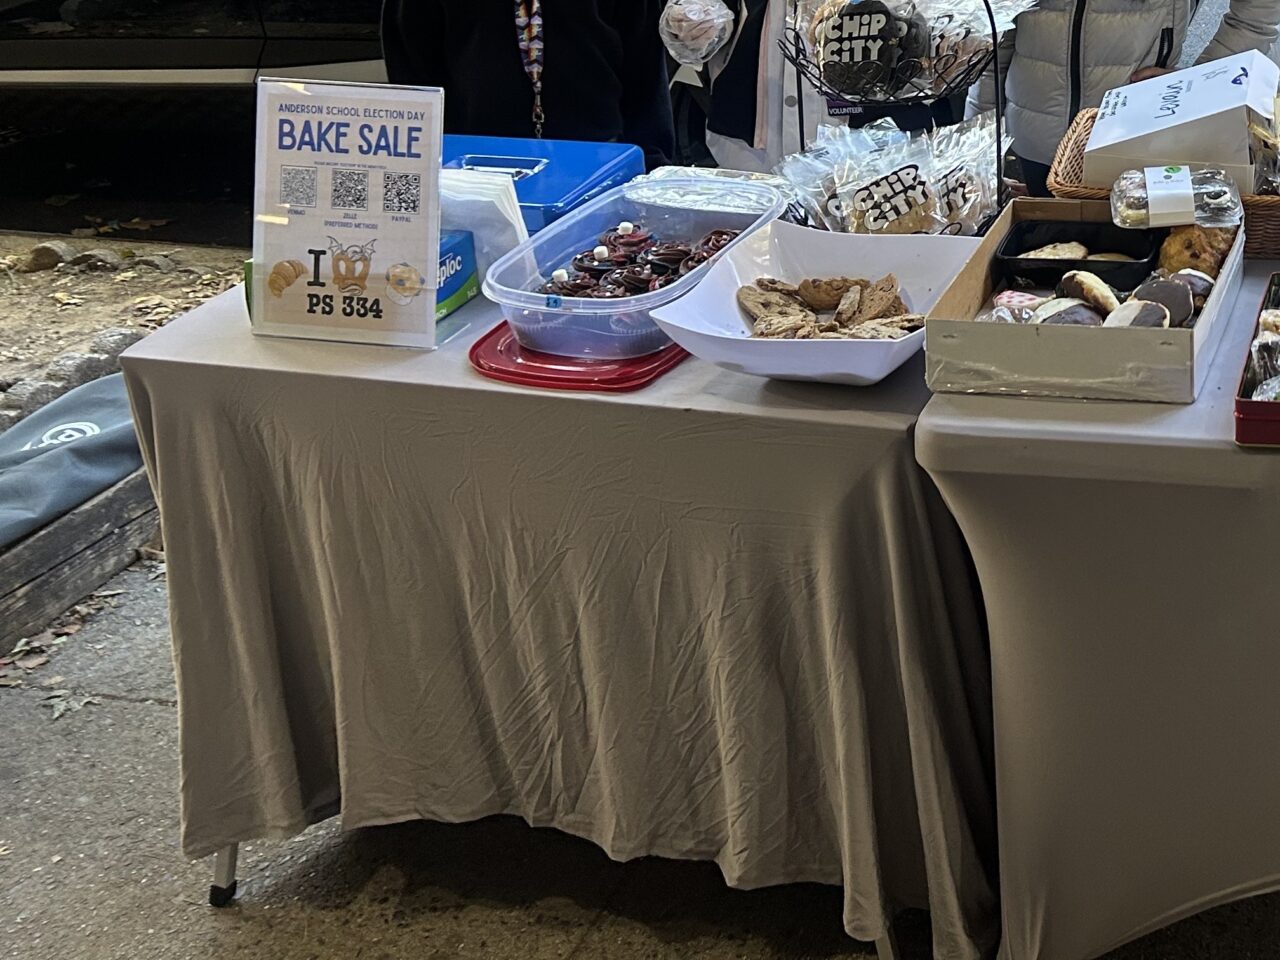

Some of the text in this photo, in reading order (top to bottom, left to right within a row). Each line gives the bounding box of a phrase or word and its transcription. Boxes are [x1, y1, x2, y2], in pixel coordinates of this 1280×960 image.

[278, 103, 425, 121] ANDERSON SCHOOL ELECTION DAY
[828, 106, 863, 115] VOLUNTEER
[1154, 80, 1184, 119] Levain
[278, 118, 422, 159] BAKE SALE
[307, 293, 383, 319] PS 334
